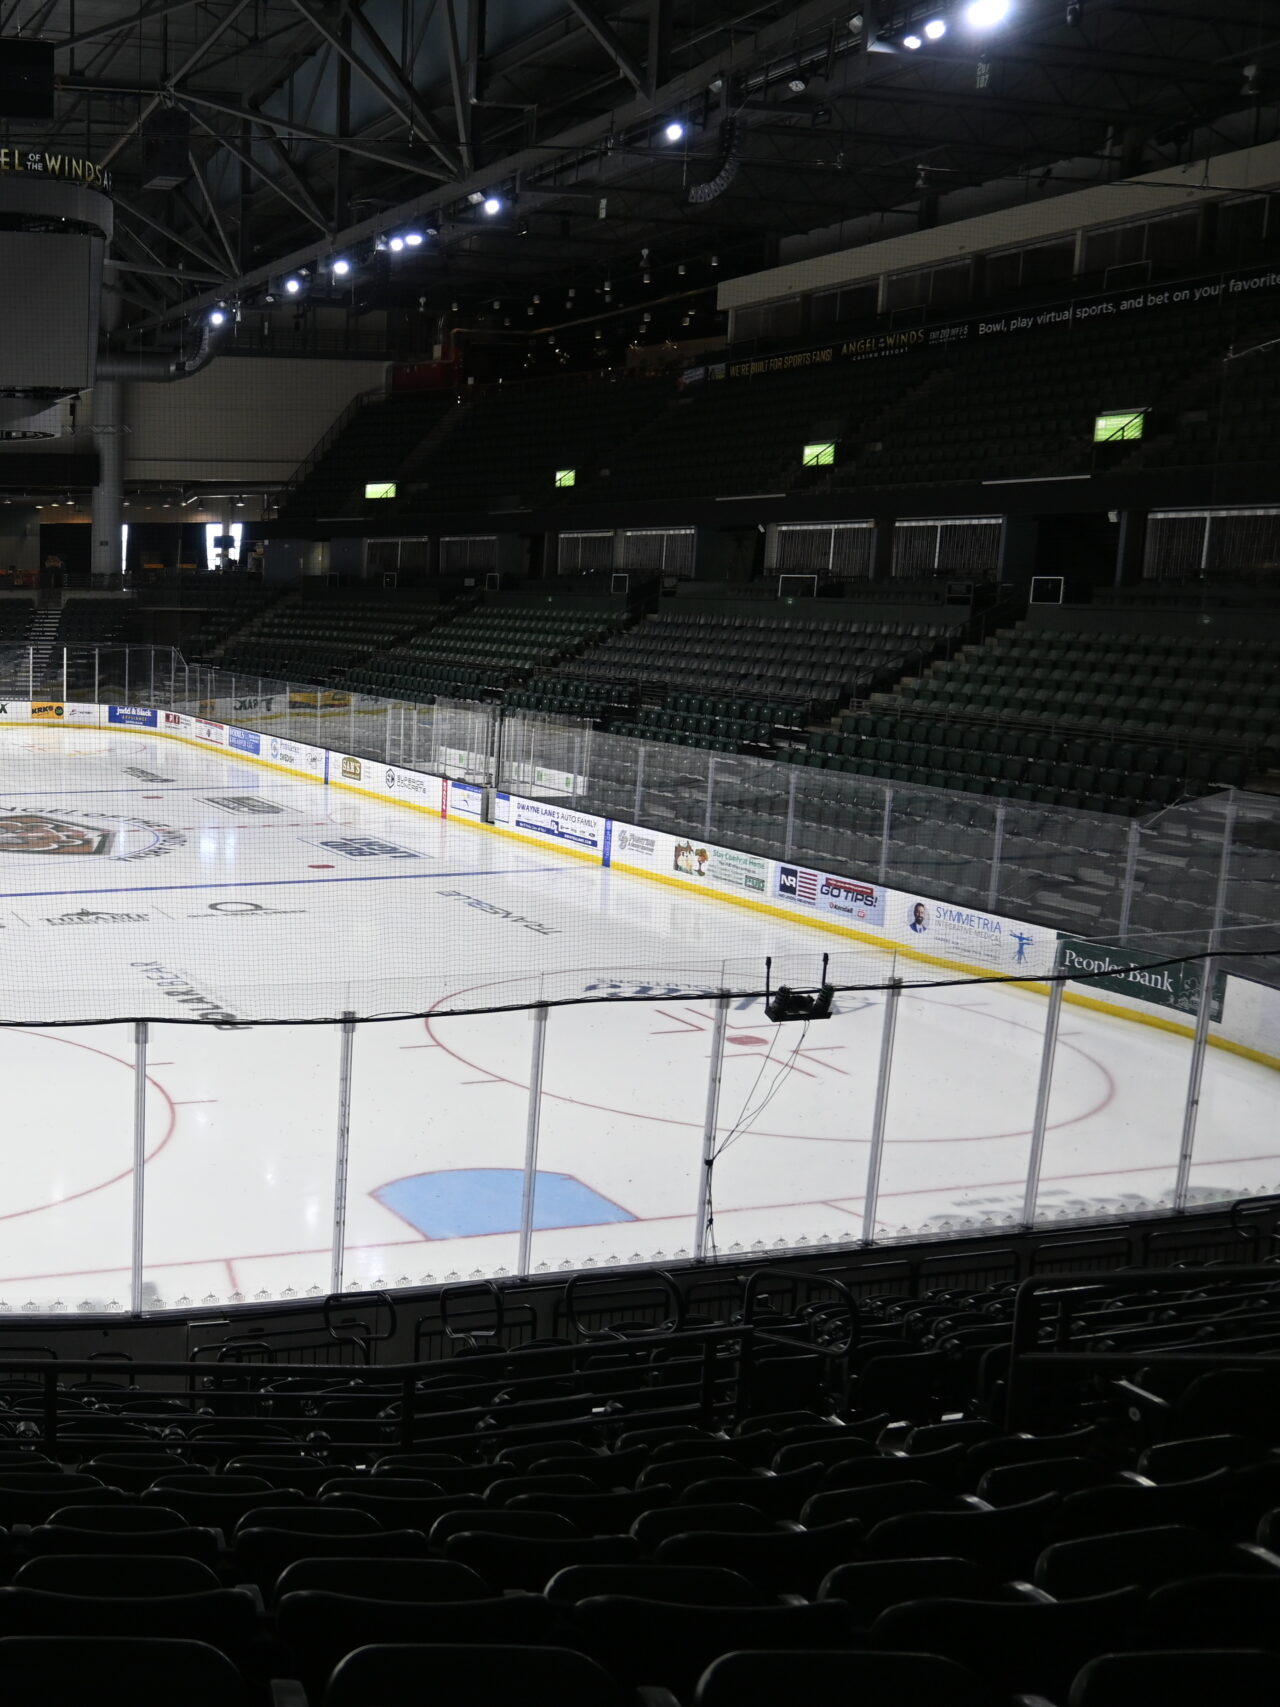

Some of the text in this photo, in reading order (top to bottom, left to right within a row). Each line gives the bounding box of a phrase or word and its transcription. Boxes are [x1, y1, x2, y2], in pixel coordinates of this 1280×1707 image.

[26, 162, 44, 171] THE
[28, 153, 41, 162] OF
[45, 152, 103, 186] WINDS
[978, 319, 1008, 335] Bowl,
[1010, 316, 1034, 332] play
[1036, 307, 1073, 325] virtual
[1075, 302, 1117, 320] sports,
[1120, 294, 1144, 311] and
[1147, 290, 1170, 306] bet
[1172, 289, 1190, 302] on
[1194, 284, 1226, 301] your
[841, 337, 877, 358] ANGEL
[886, 328, 926, 348] WINDS
[750, 360, 770, 375] BUILT
[769, 357, 783, 370] FOR
[783, 353, 811, 369] SPORTS
[517, 802, 540, 814] DWAYNE
[560, 812, 577, 823] AUTO
[577, 817, 597, 828] FAMILY
[820, 883, 841, 898] GO
[843, 889, 879, 908] TIPS!
[834, 903, 854, 914] Kendall
[935, 906, 1002, 934] SYMMETRIA
[1127, 962, 1175, 993] Bank
